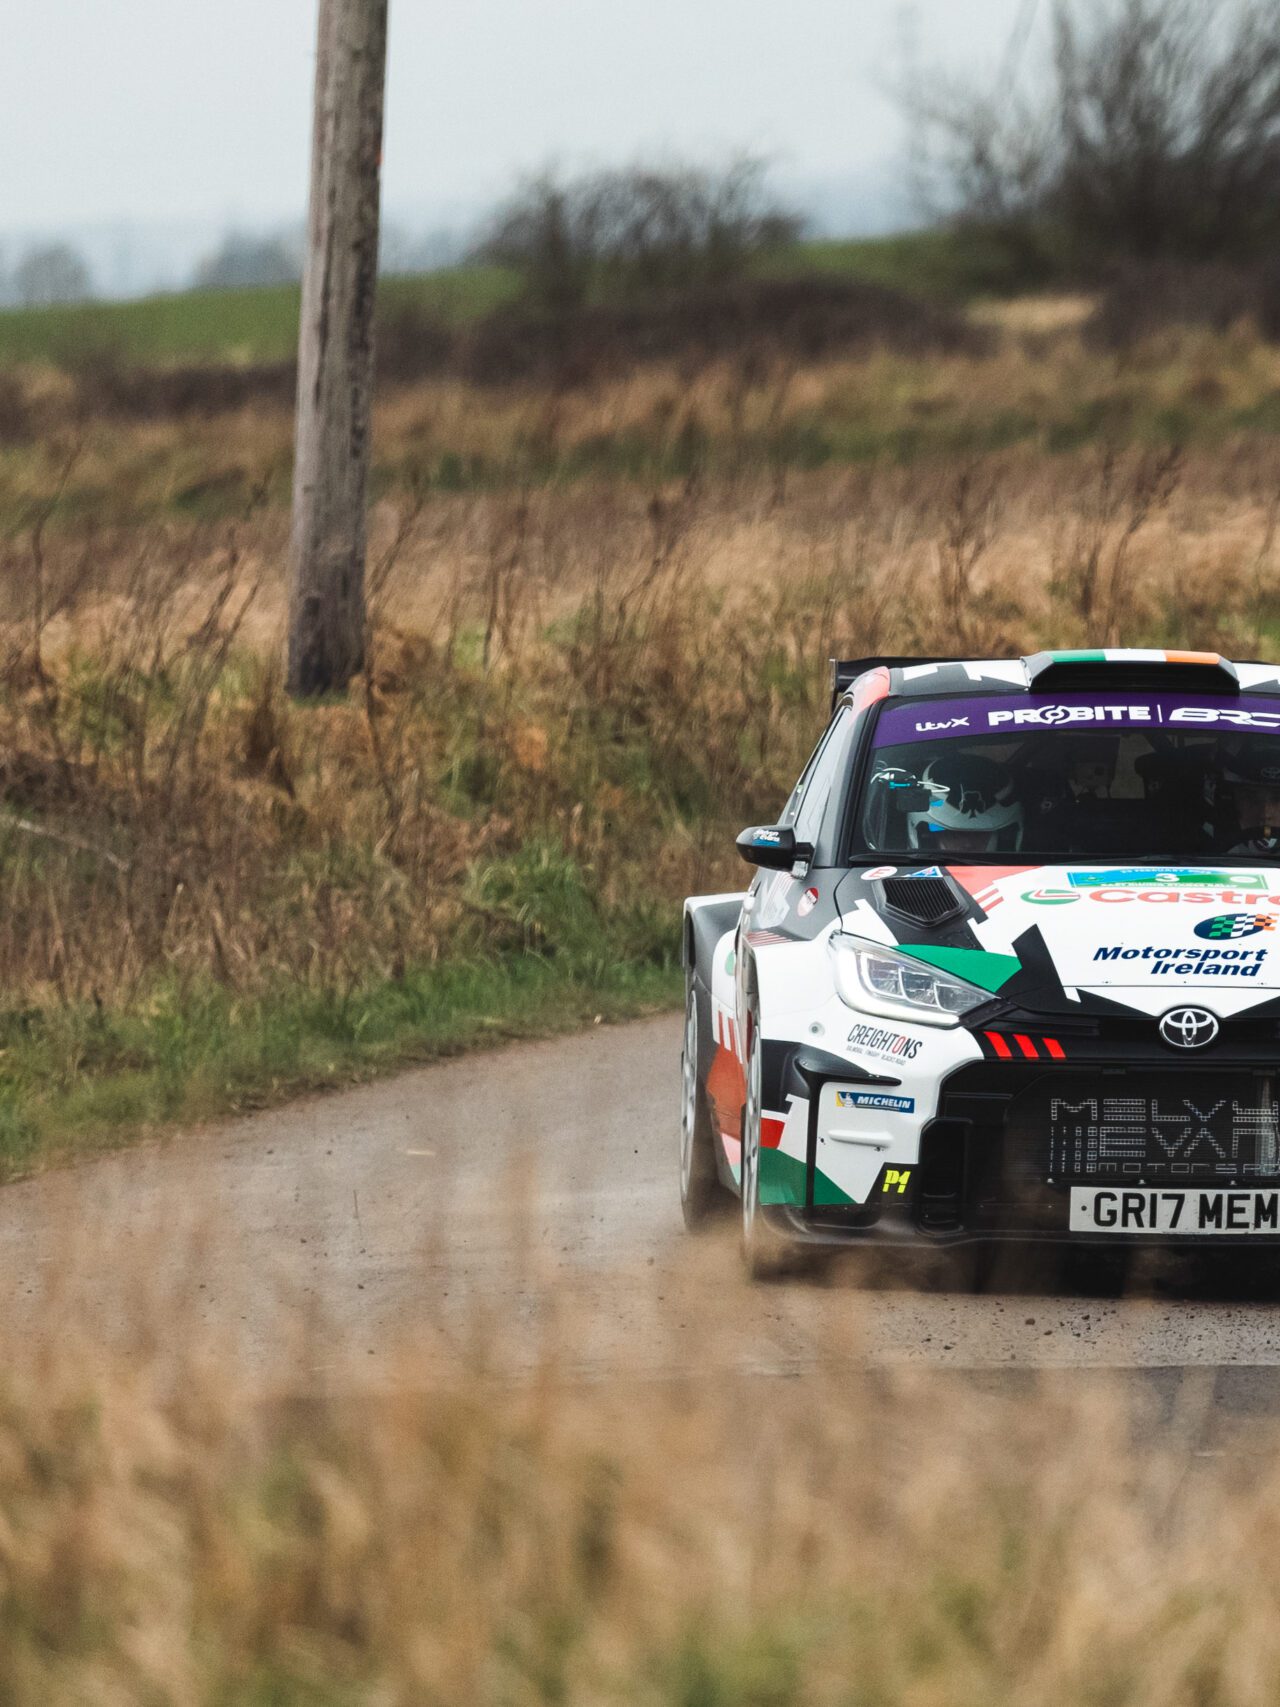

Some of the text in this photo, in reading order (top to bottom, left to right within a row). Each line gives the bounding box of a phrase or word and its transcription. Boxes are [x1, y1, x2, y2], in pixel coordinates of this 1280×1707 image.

[988, 705, 1152, 726] PROBITE
[868, 868, 891, 878] E
[1155, 873, 1180, 882] 3
[1092, 946, 1269, 962] Motorsport
[1150, 960, 1263, 977] Ireland
[847, 1023, 923, 1059] CREIGHTONS
[857, 1096, 911, 1109] MICHELIN
[1093, 1192, 1279, 1229] GR17 MEM
